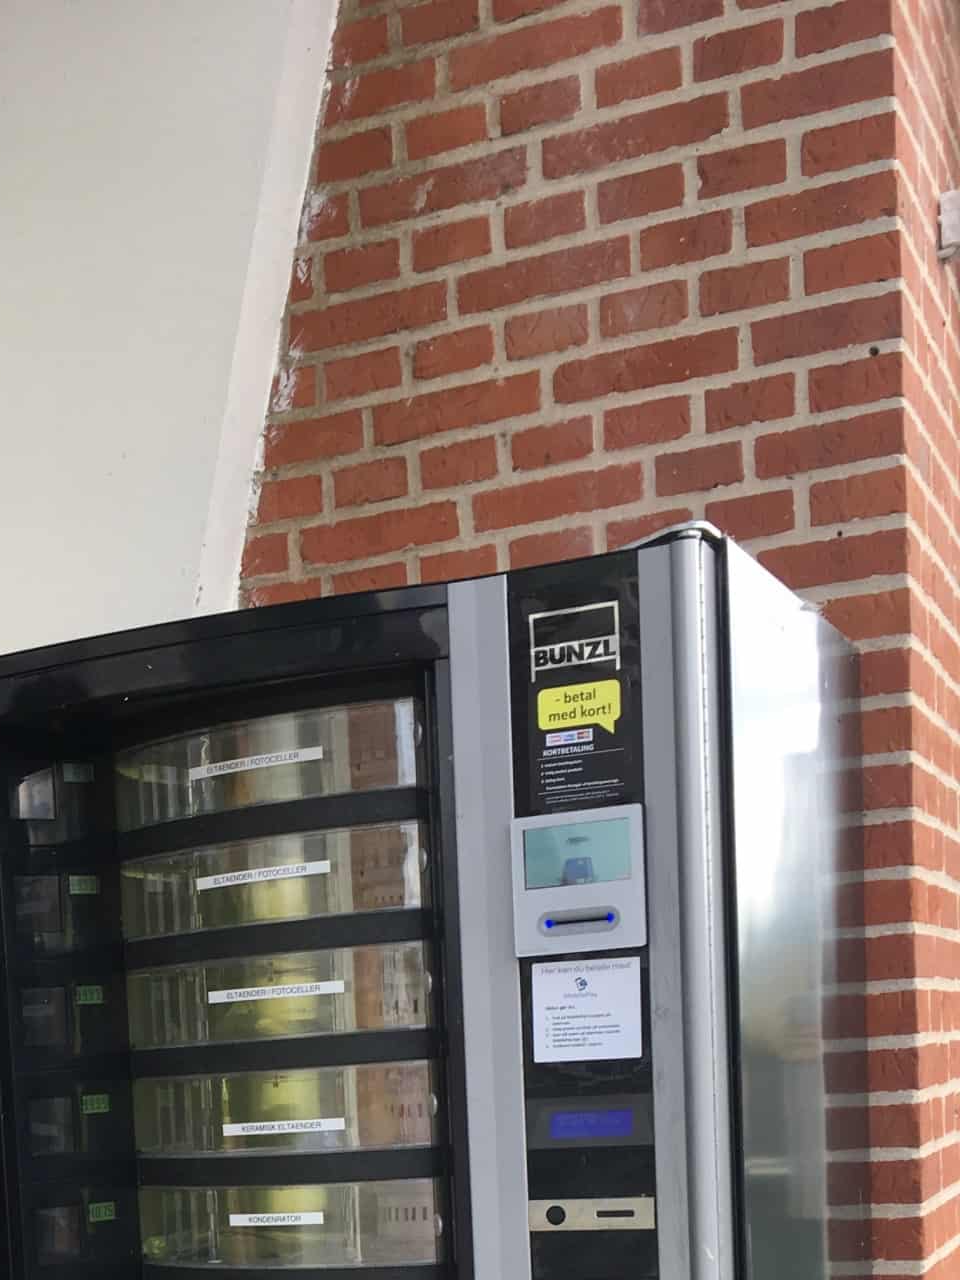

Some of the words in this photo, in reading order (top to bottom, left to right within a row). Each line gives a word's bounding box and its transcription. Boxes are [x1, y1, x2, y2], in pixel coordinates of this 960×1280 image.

[535, 640, 617, 667] BUNZL
[564, 688, 596, 704] betal
[548, 708, 577, 722] med
[580, 703, 612, 718] kort!
